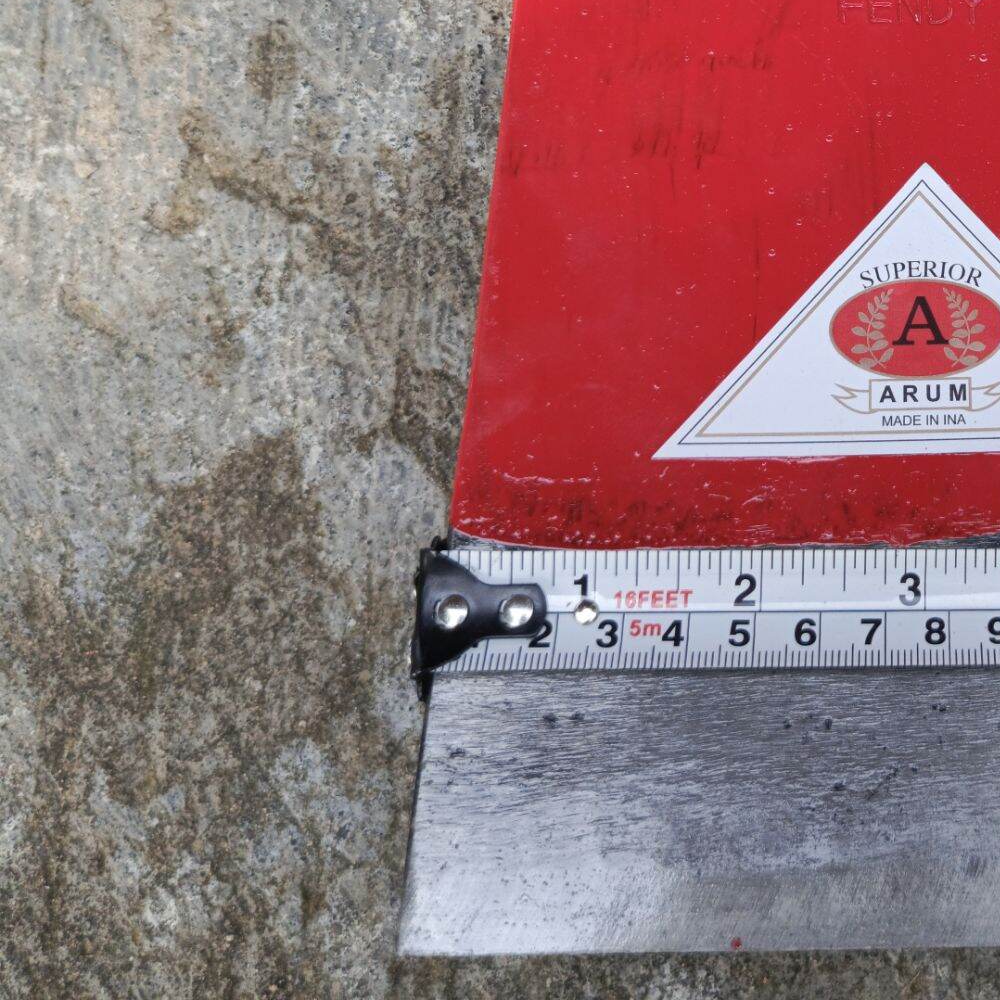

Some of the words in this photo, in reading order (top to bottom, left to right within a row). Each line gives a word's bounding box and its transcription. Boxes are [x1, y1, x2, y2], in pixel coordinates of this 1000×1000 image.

[859, 260, 983, 289] SUPERIOR
[892, 296, 949, 345] A
[879, 383, 967, 403] ARUM
[882, 415, 922, 426] MADE
[925, 415, 940, 425] IN
[943, 414, 967, 425] INA
[573, 574, 589, 597] 1
[734, 574, 757, 607] 2
[900, 573, 921, 606] 3
[614, 589, 694, 609] 16FEET
[529, 619, 553, 648] 2
[596, 620, 618, 648] 3
[661, 620, 684, 647] 4
[729, 620, 750, 647] 5
[795, 619, 817, 646] 6
[861, 618, 883, 645] 7
[924, 618, 947, 645] 8
[630, 619, 661, 637] 5m
